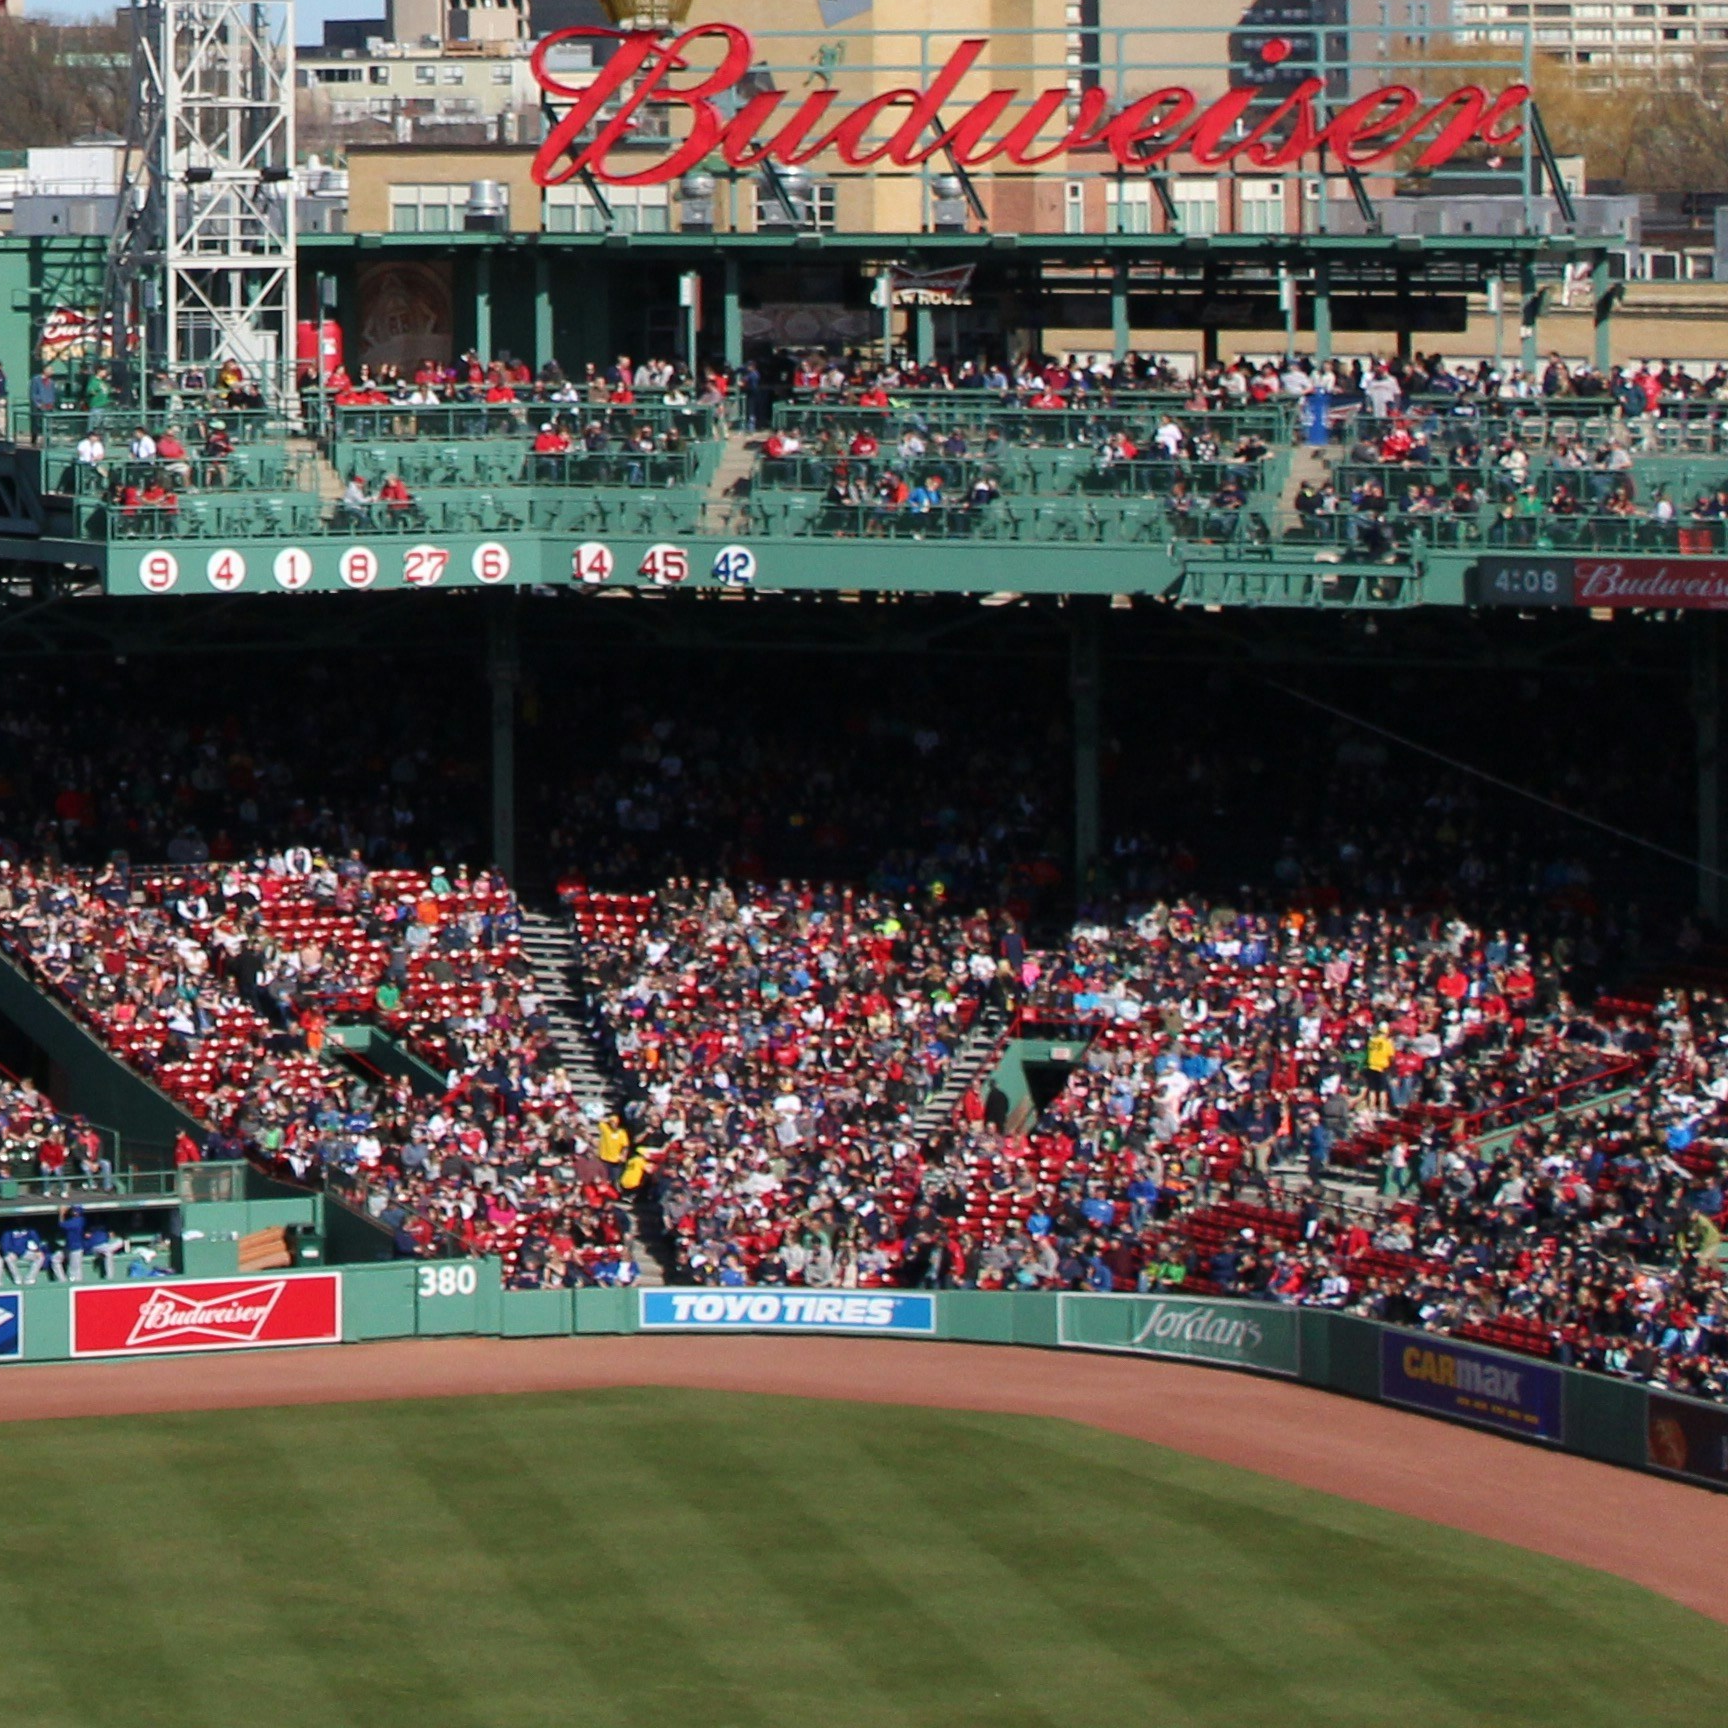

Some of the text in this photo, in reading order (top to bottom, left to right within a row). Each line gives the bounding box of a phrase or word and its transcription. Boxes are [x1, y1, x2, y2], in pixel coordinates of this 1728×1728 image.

[530, 22, 1531, 187] Budweiser
[149, 549, 501, 588] 9 4 1 8 27 6
[572, 548, 750, 583] 14 45 42
[1494, 569, 1558, 594] 4:08
[417, 1265, 477, 1298] 380
[139, 1297, 269, 1331] Budweiser
[671, 1294, 896, 1324] TOYO TIRES
[1133, 1303, 1264, 1349] Jordan's
